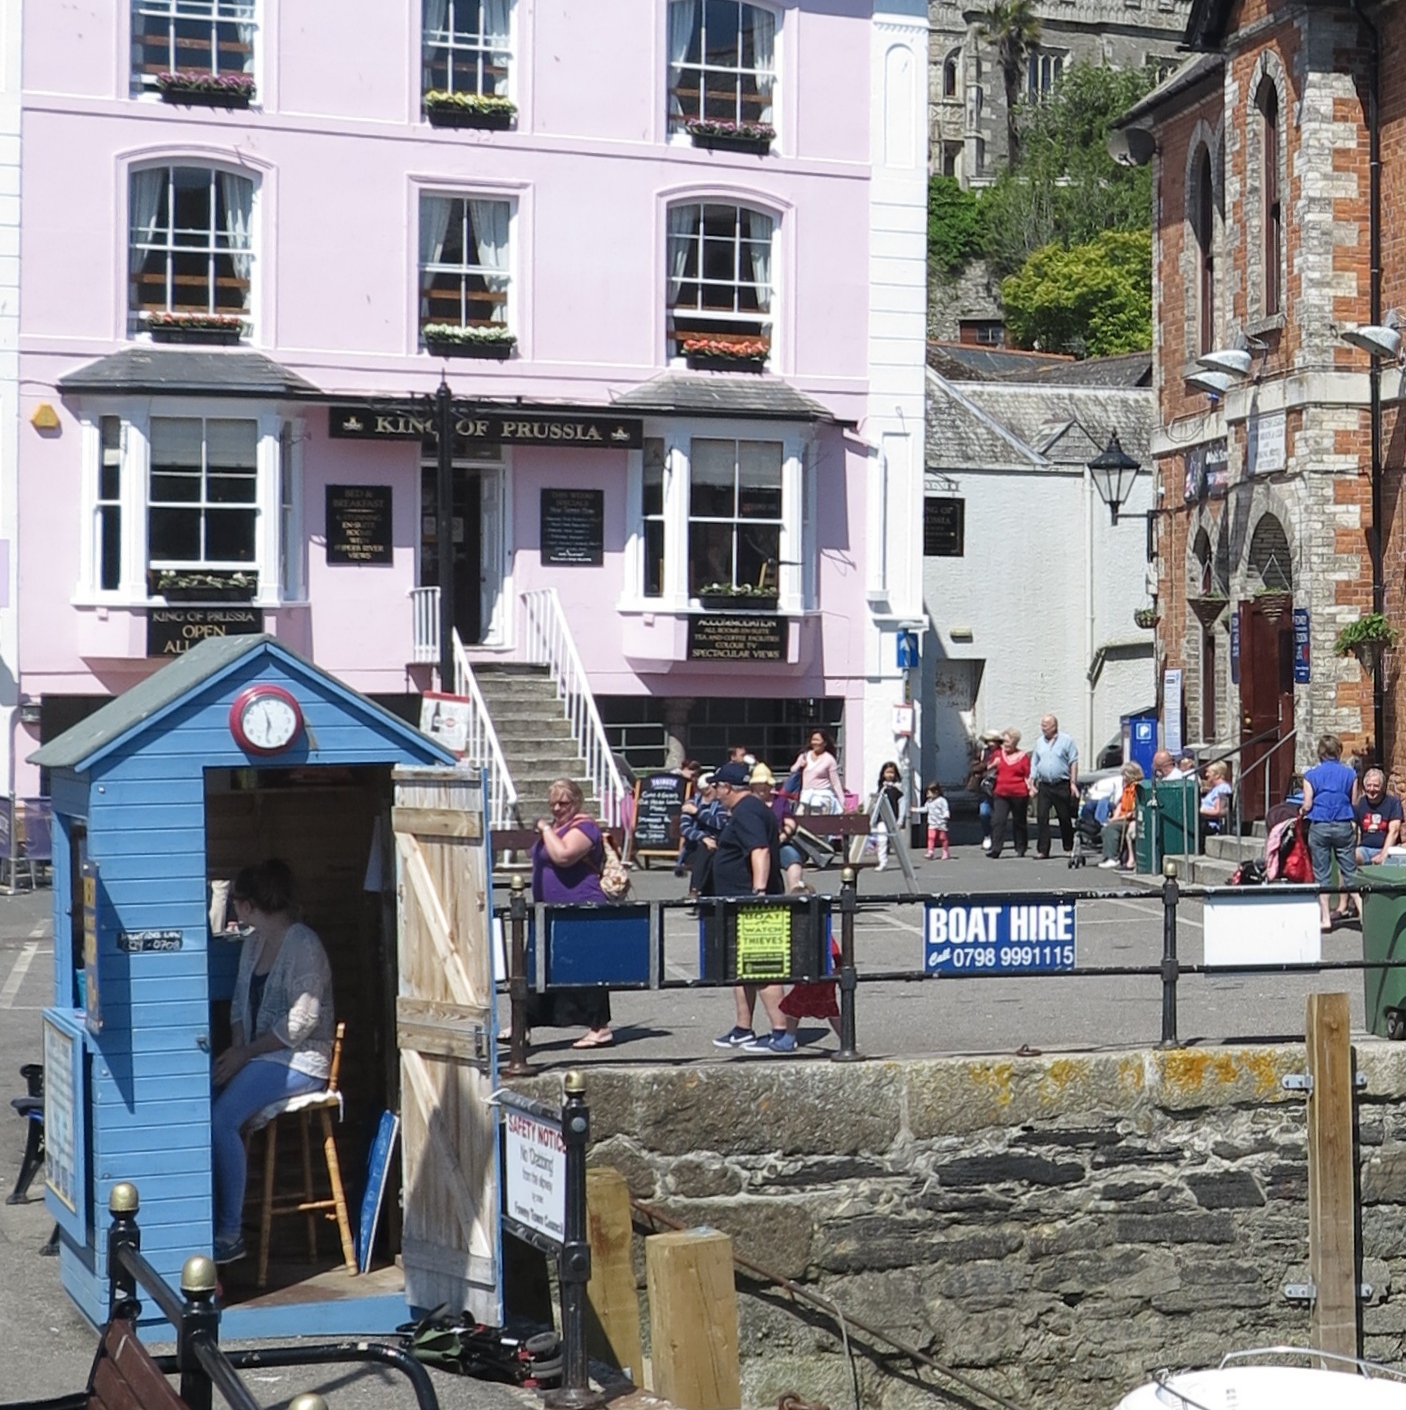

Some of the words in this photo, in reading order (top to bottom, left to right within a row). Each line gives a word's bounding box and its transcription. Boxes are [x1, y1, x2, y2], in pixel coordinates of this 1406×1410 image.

[455, 418, 489, 436] OF
[501, 421, 602, 440] PRUSSIA
[153, 611, 184, 621] KING
[186, 611, 203, 621] OF
[206, 611, 255, 622] PRUSSIA
[182, 625, 225, 638] OPEN
[163, 640, 190, 653] ALL
[692, 649, 750, 657] SPECTACULAR
[753, 650, 779, 658] VIEWS
[929, 906, 1002, 943] BOAT
[1010, 905, 1072, 941] HIRE
[743, 936, 783, 945] THIEVES
[929, 947, 951, 967] Call
[953, 947, 996, 967] 0798
[1000, 945, 1073, 967] 9991115
[509, 1115, 536, 1142] SAFETY
